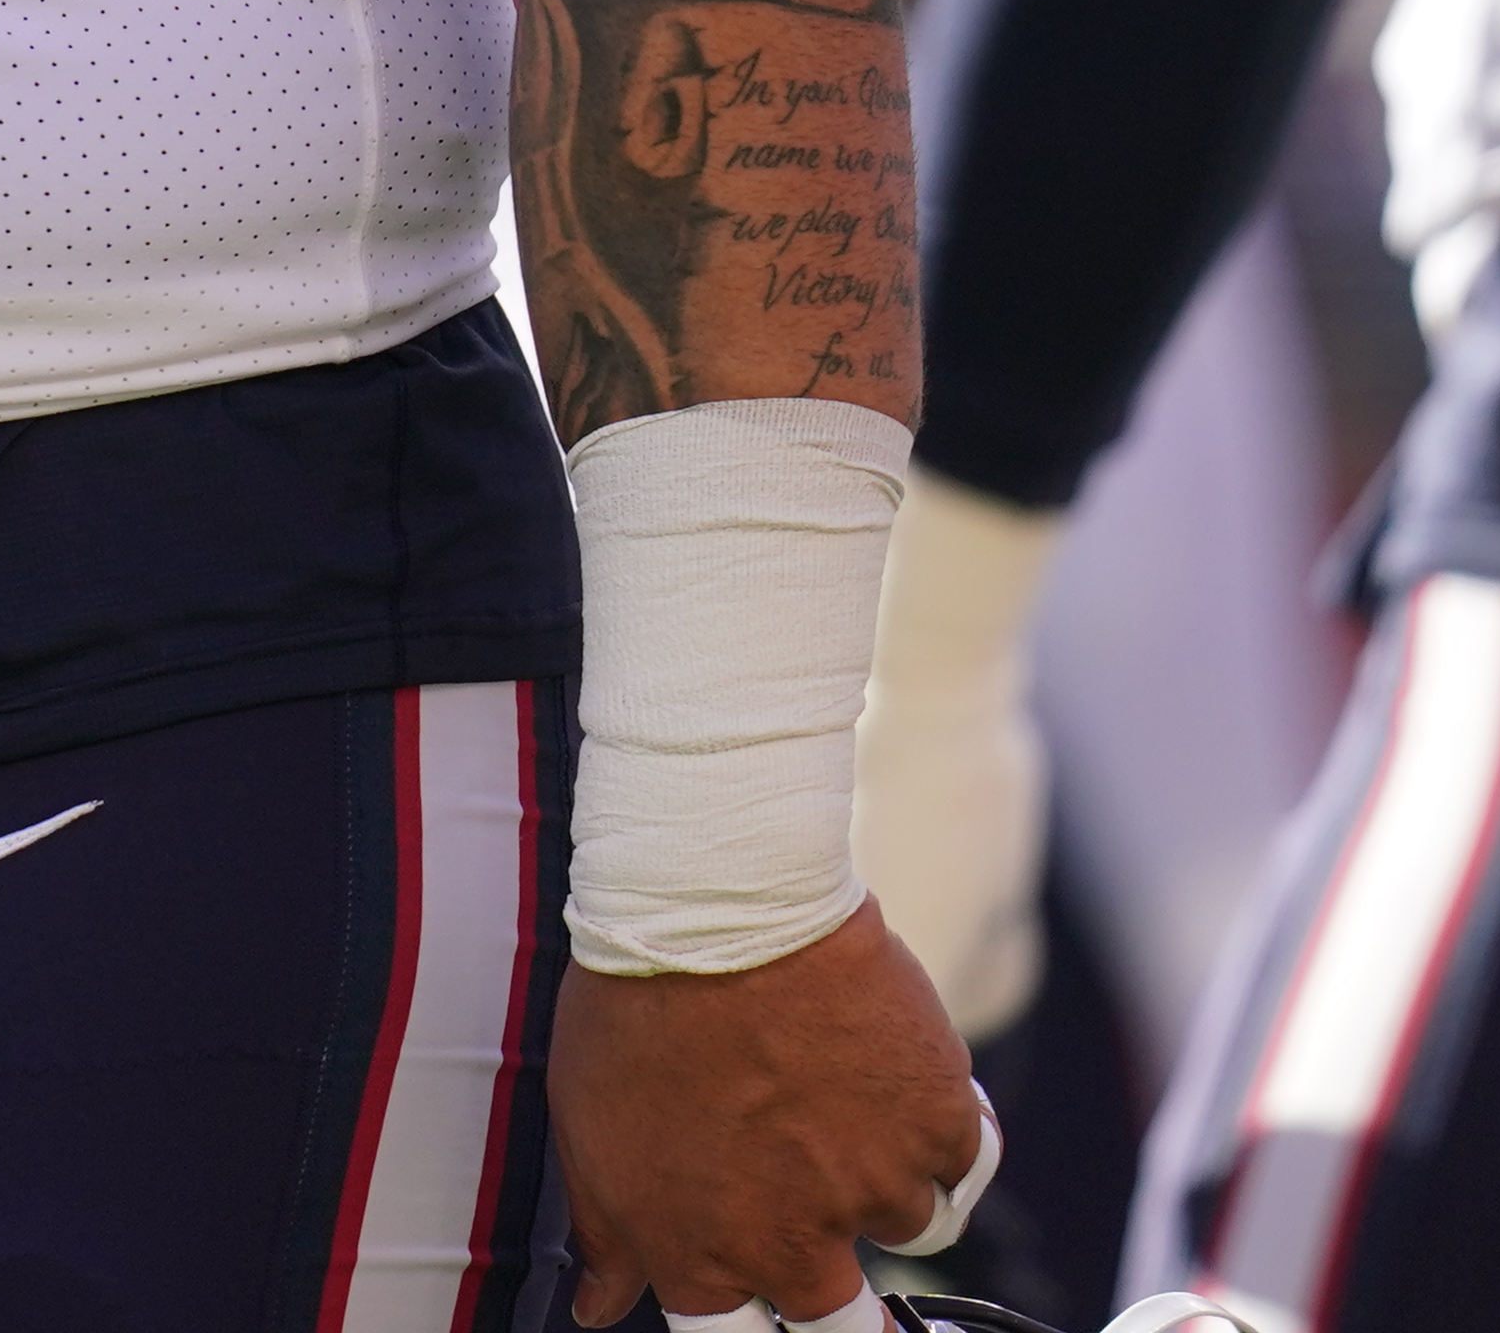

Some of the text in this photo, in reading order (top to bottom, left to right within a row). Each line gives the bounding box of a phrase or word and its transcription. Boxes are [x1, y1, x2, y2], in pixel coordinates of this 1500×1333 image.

[725, 143, 821, 171] name
[834, 144, 875, 172] we
[731, 212, 788, 241] we
[777, 194, 862, 258] play
[763, 262, 880, 332] Victory
[799, 331, 856, 399] for
